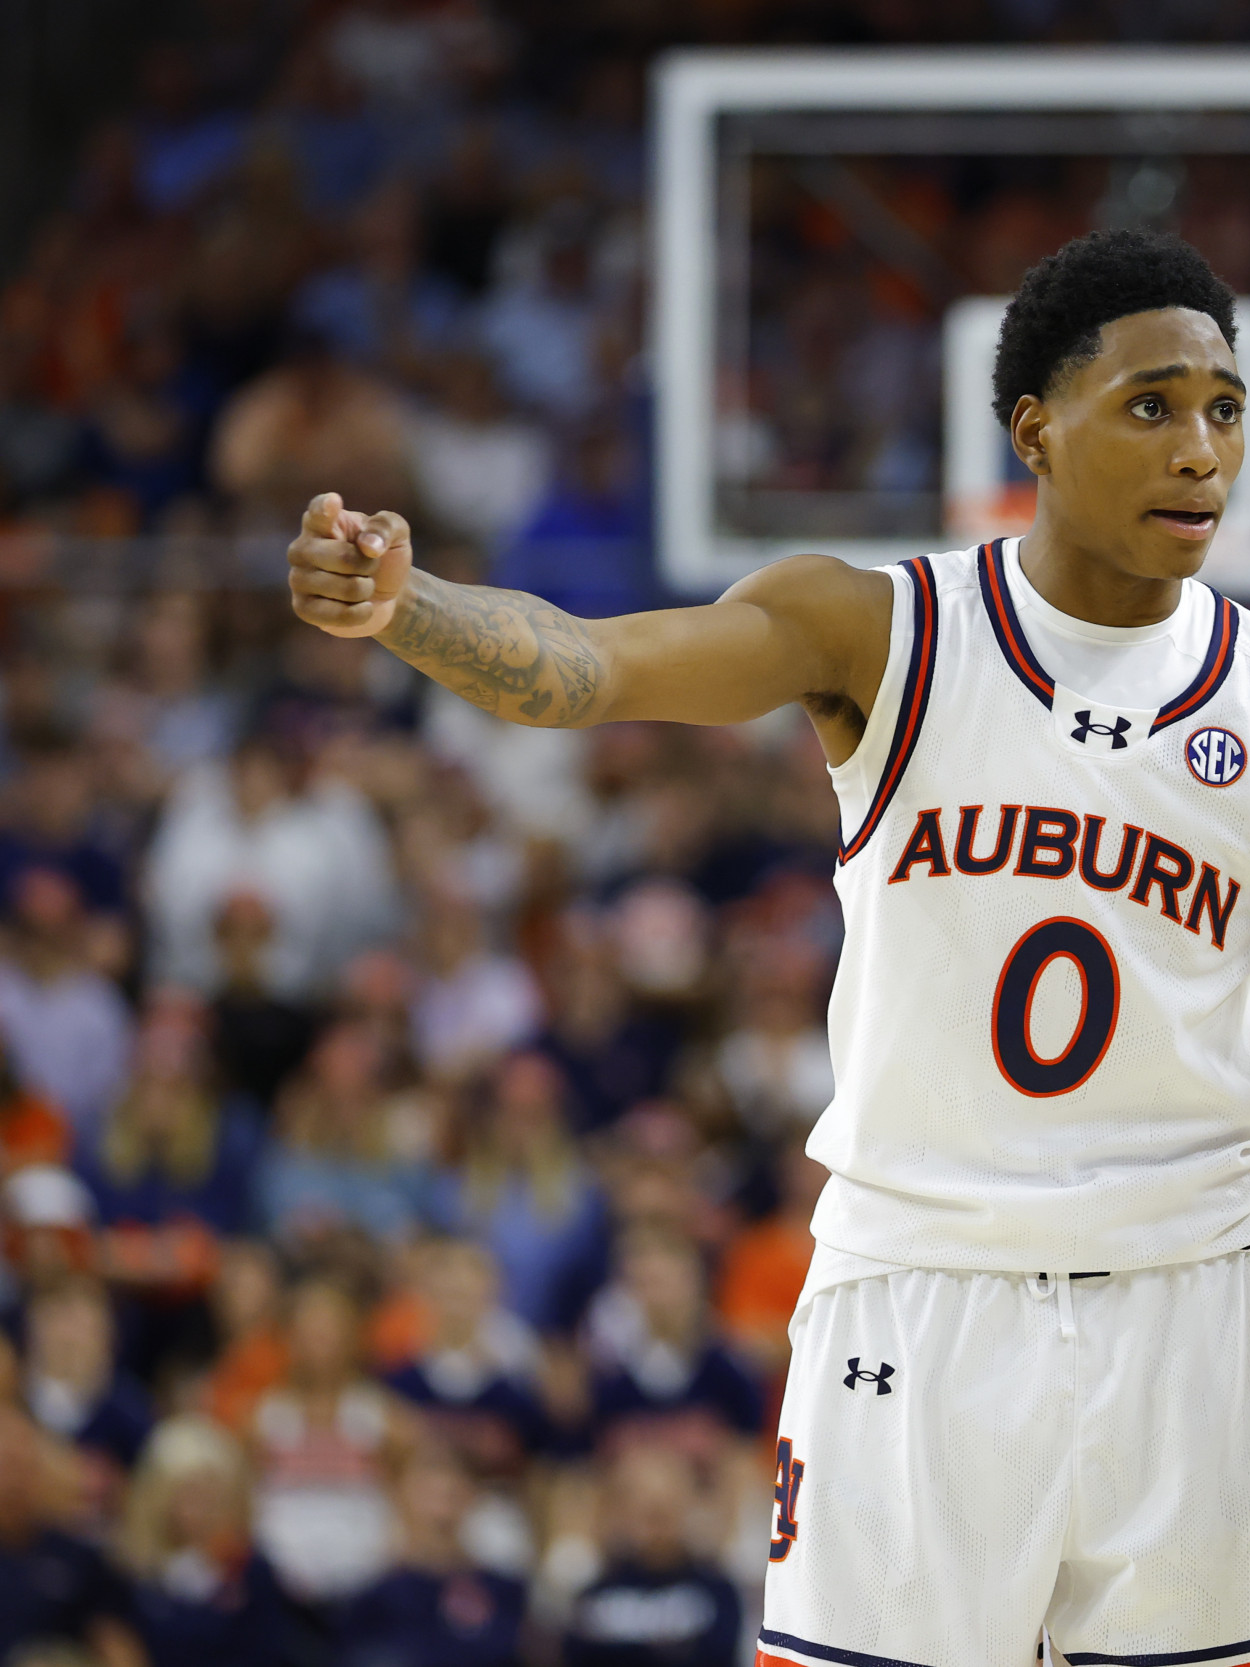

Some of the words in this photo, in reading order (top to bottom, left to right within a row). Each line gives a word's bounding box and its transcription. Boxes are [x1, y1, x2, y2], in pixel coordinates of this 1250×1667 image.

[1190, 729, 1242, 783] SEC
[887, 804, 1241, 951] AUBURN
[990, 915, 1121, 1099] 0
